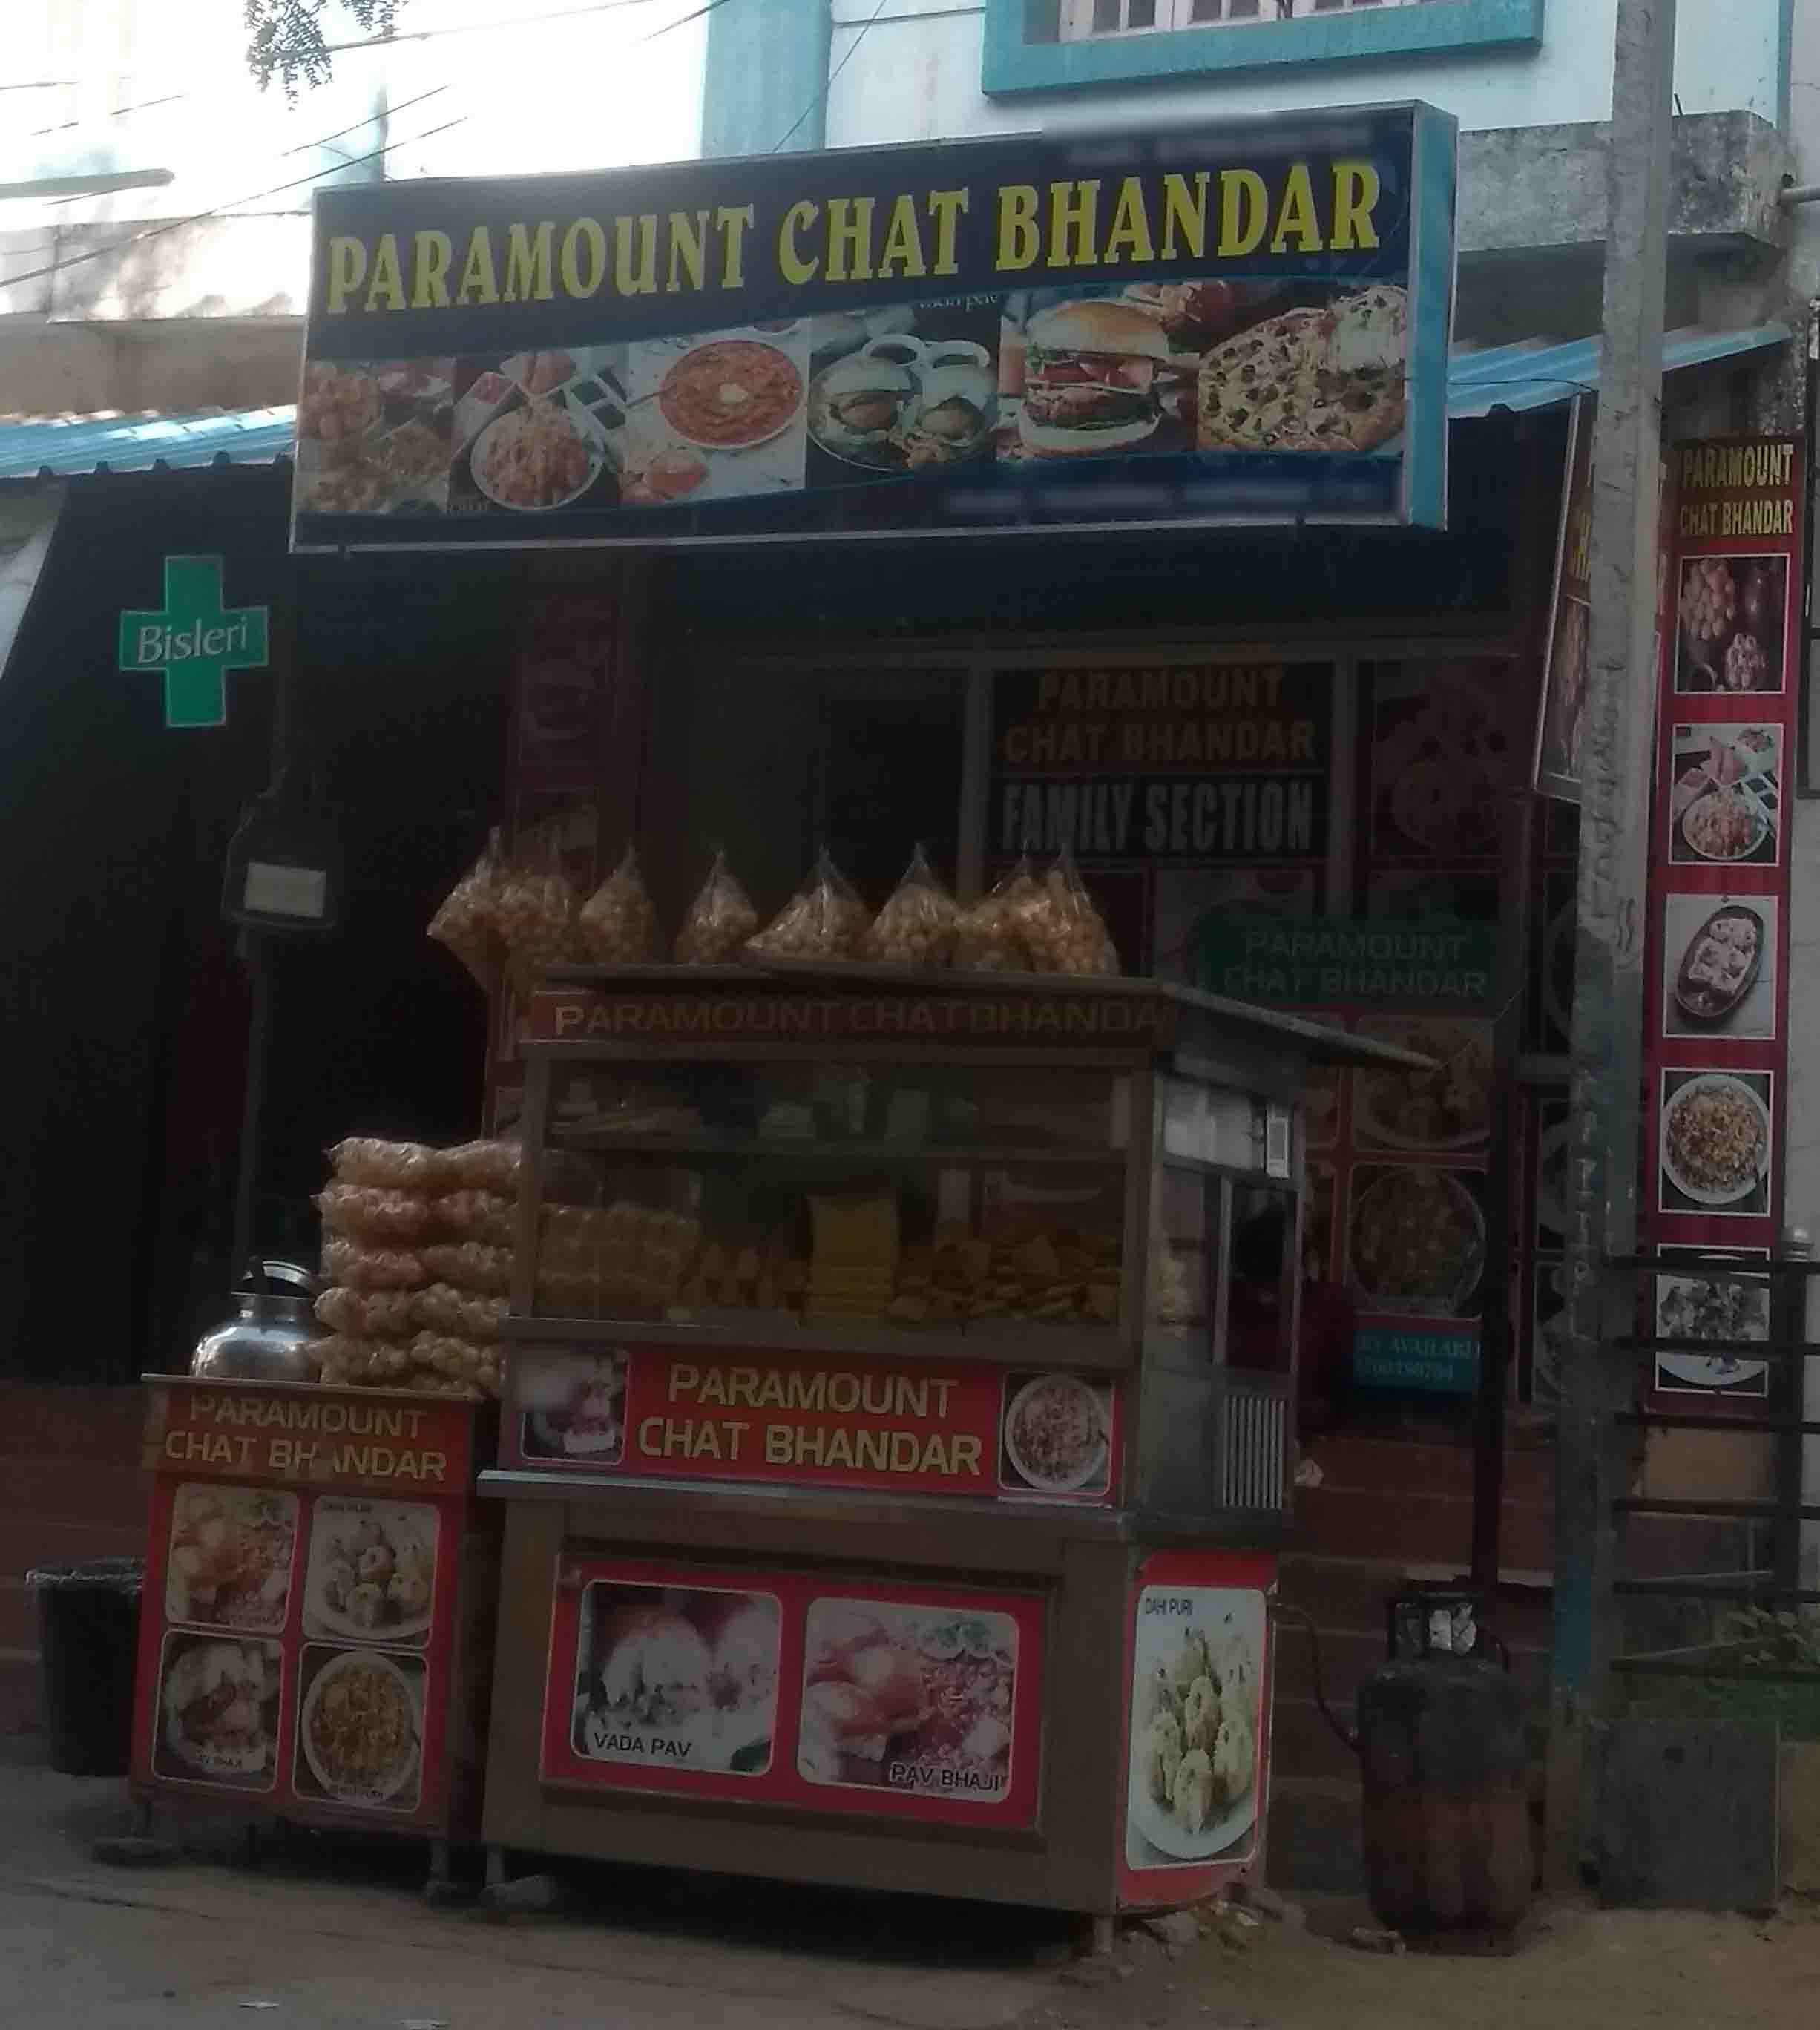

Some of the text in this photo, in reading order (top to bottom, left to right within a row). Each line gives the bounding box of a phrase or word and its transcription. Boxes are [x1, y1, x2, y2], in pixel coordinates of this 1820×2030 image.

[327, 160, 1382, 315] PARAMOUNT CHAT BHANDAR
[1682, 443, 1793, 487] PARAMOUNT
[1680, 499, 1794, 535] CHAT BHANDAR
[137, 615, 249, 664] Bisleri
[1037, 669, 1284, 710] PARAMOUNT
[1005, 720, 1315, 763] CHAT BHANDAR
[1002, 780, 1313, 851] FAMILY SECTION
[1246, 931, 1467, 961] PARAMOUNT
[1223, 965, 1488, 998] CHAT BHANDAR
[555, 1000, 1169, 1035] PARAMOUNT CHAT BHANDA
[668, 1364, 959, 1419] PARAMOUNT
[189, 1393, 428, 1439] PARAMOUNT
[165, 1430, 258, 1465] CHAT
[638, 1416, 983, 1476] CHAT BHANDAR
[594, 1732, 692, 1757] VADA PAV
[891, 1763, 1000, 1791] PAV BHAJI
